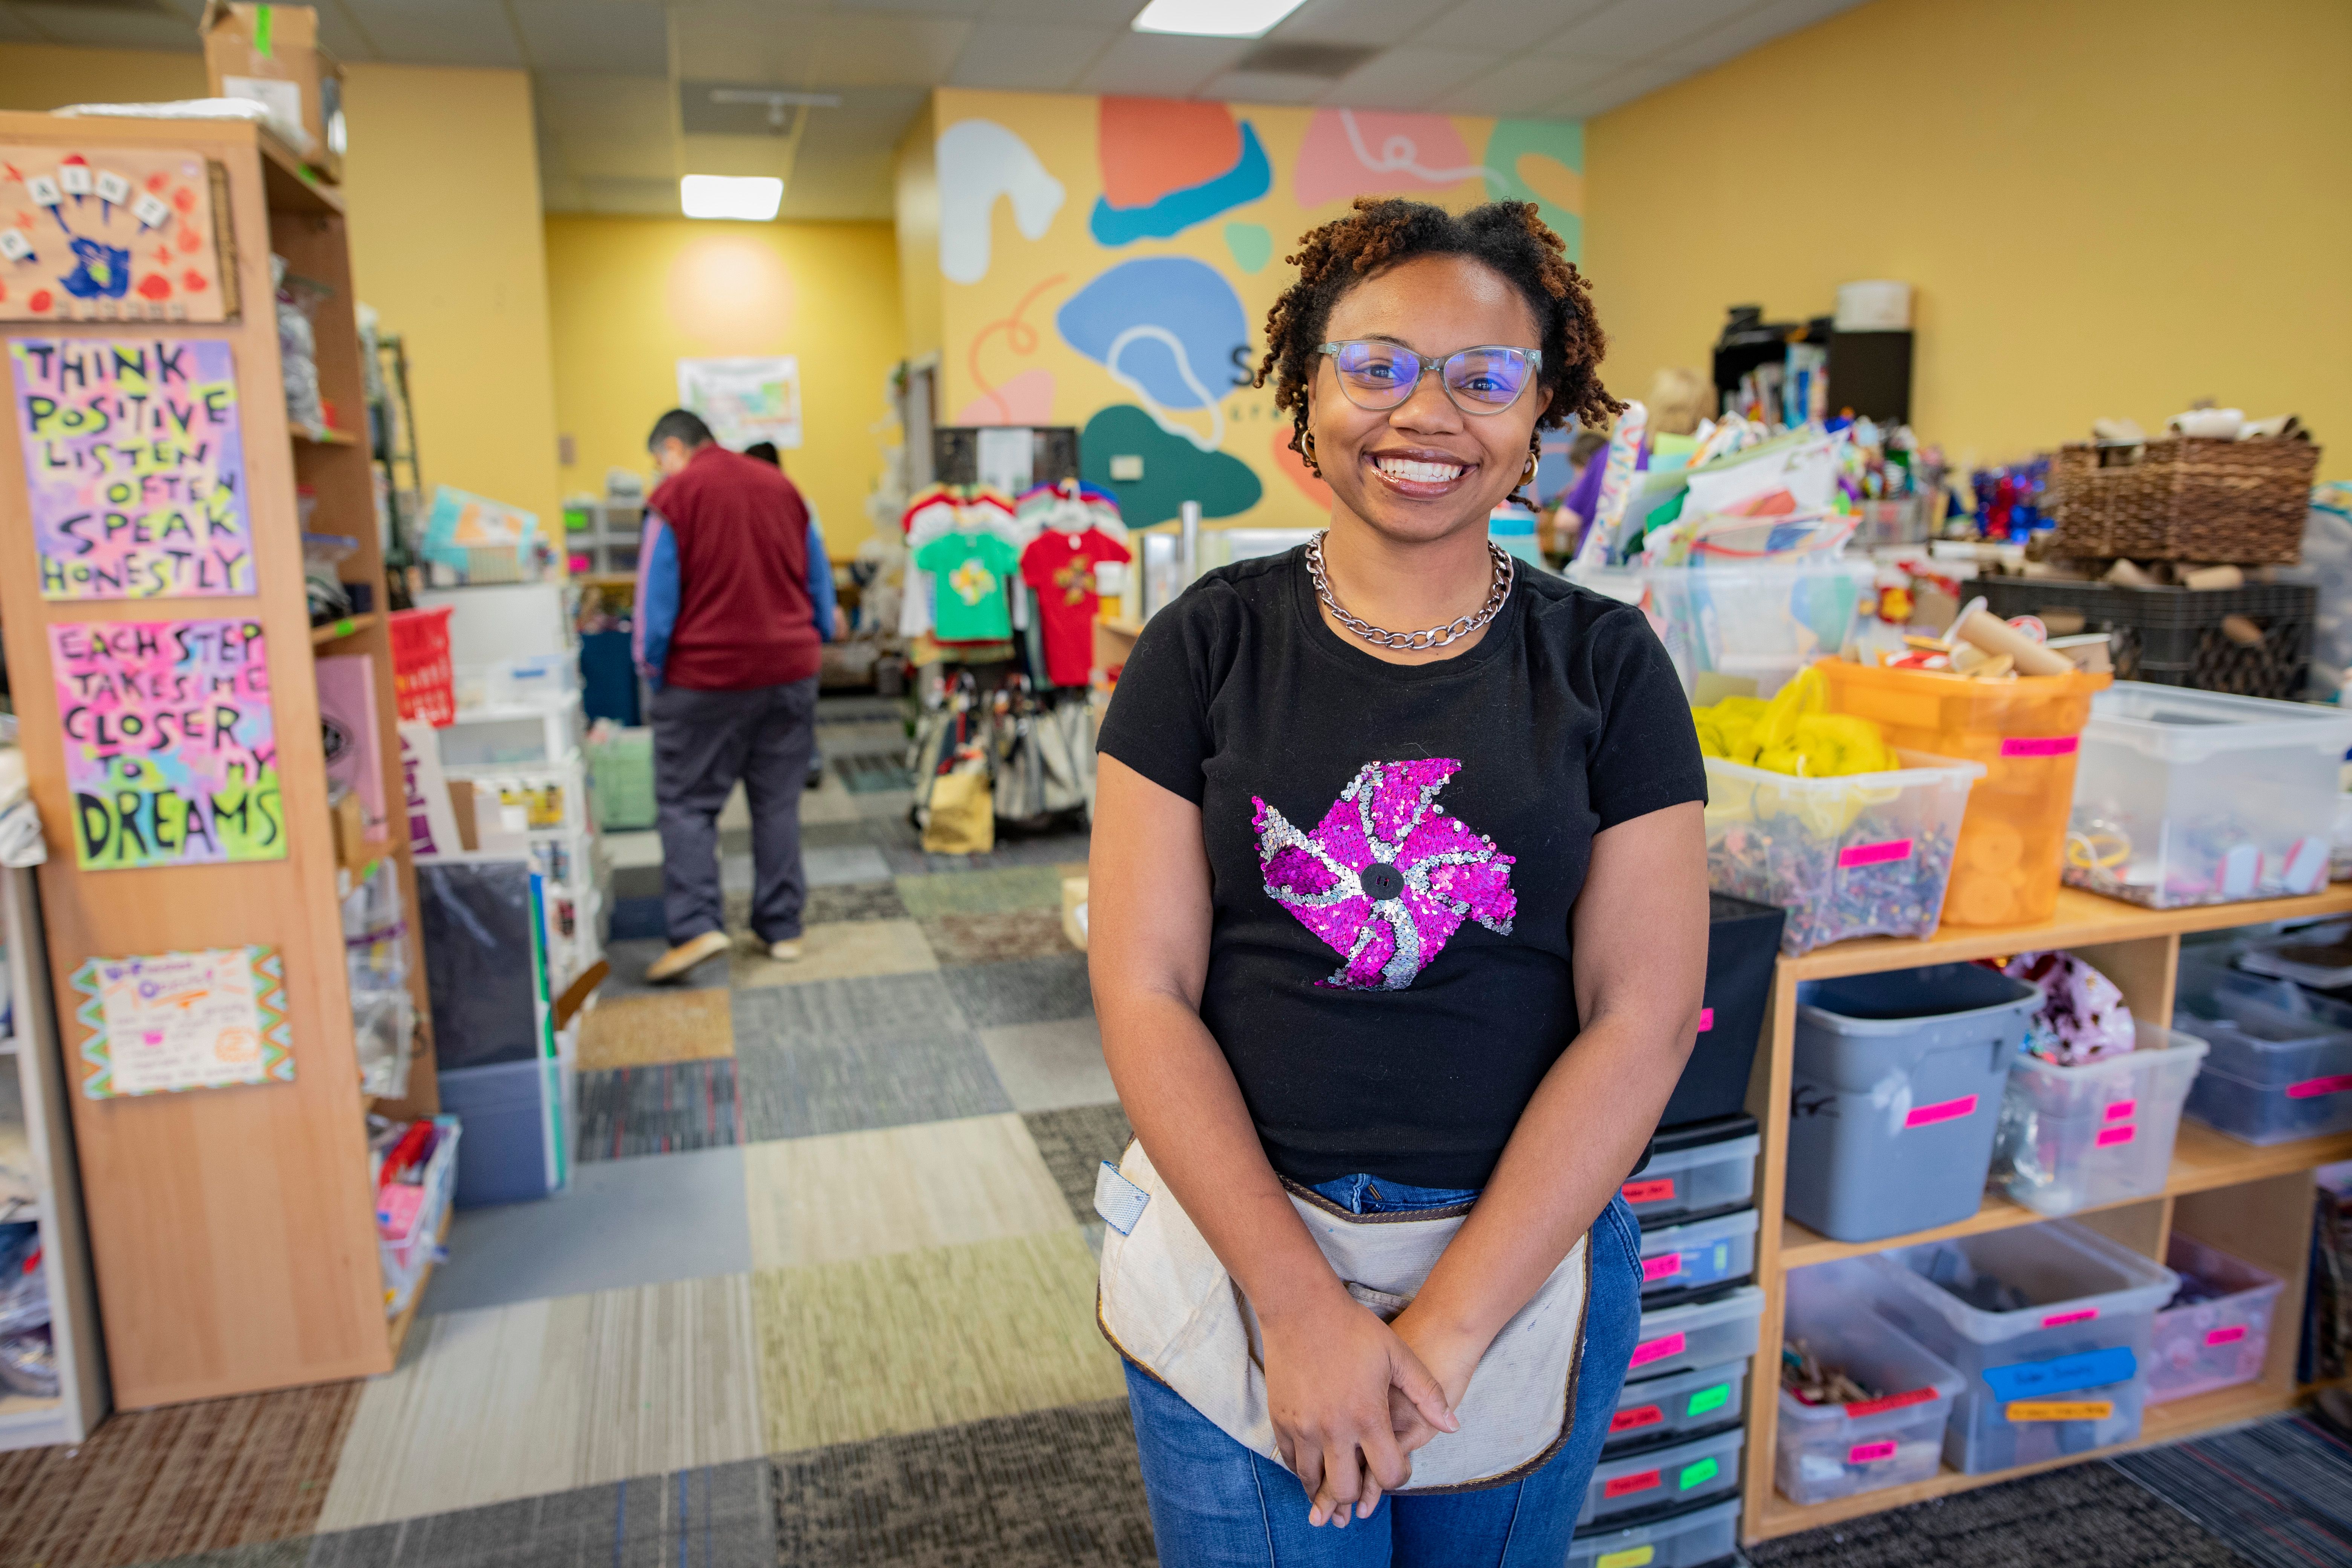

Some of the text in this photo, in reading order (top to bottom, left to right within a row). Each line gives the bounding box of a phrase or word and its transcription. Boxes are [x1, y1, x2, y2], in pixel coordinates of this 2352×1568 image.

[26, 341, 187, 393] THINK
[28, 389, 228, 434] POSITIVE
[46, 441, 207, 475] LISTEN
[107, 473, 235, 506] OFTEN
[57, 506, 237, 554] SPEAK
[41, 548, 245, 595] HONESTLY
[58, 622, 262, 662] EACH STEP
[72, 666, 267, 702] TAKES ME
[64, 704, 240, 750] CLOSER
[95, 750, 276, 781] TO MY
[77, 788, 278, 861] DREAMS
